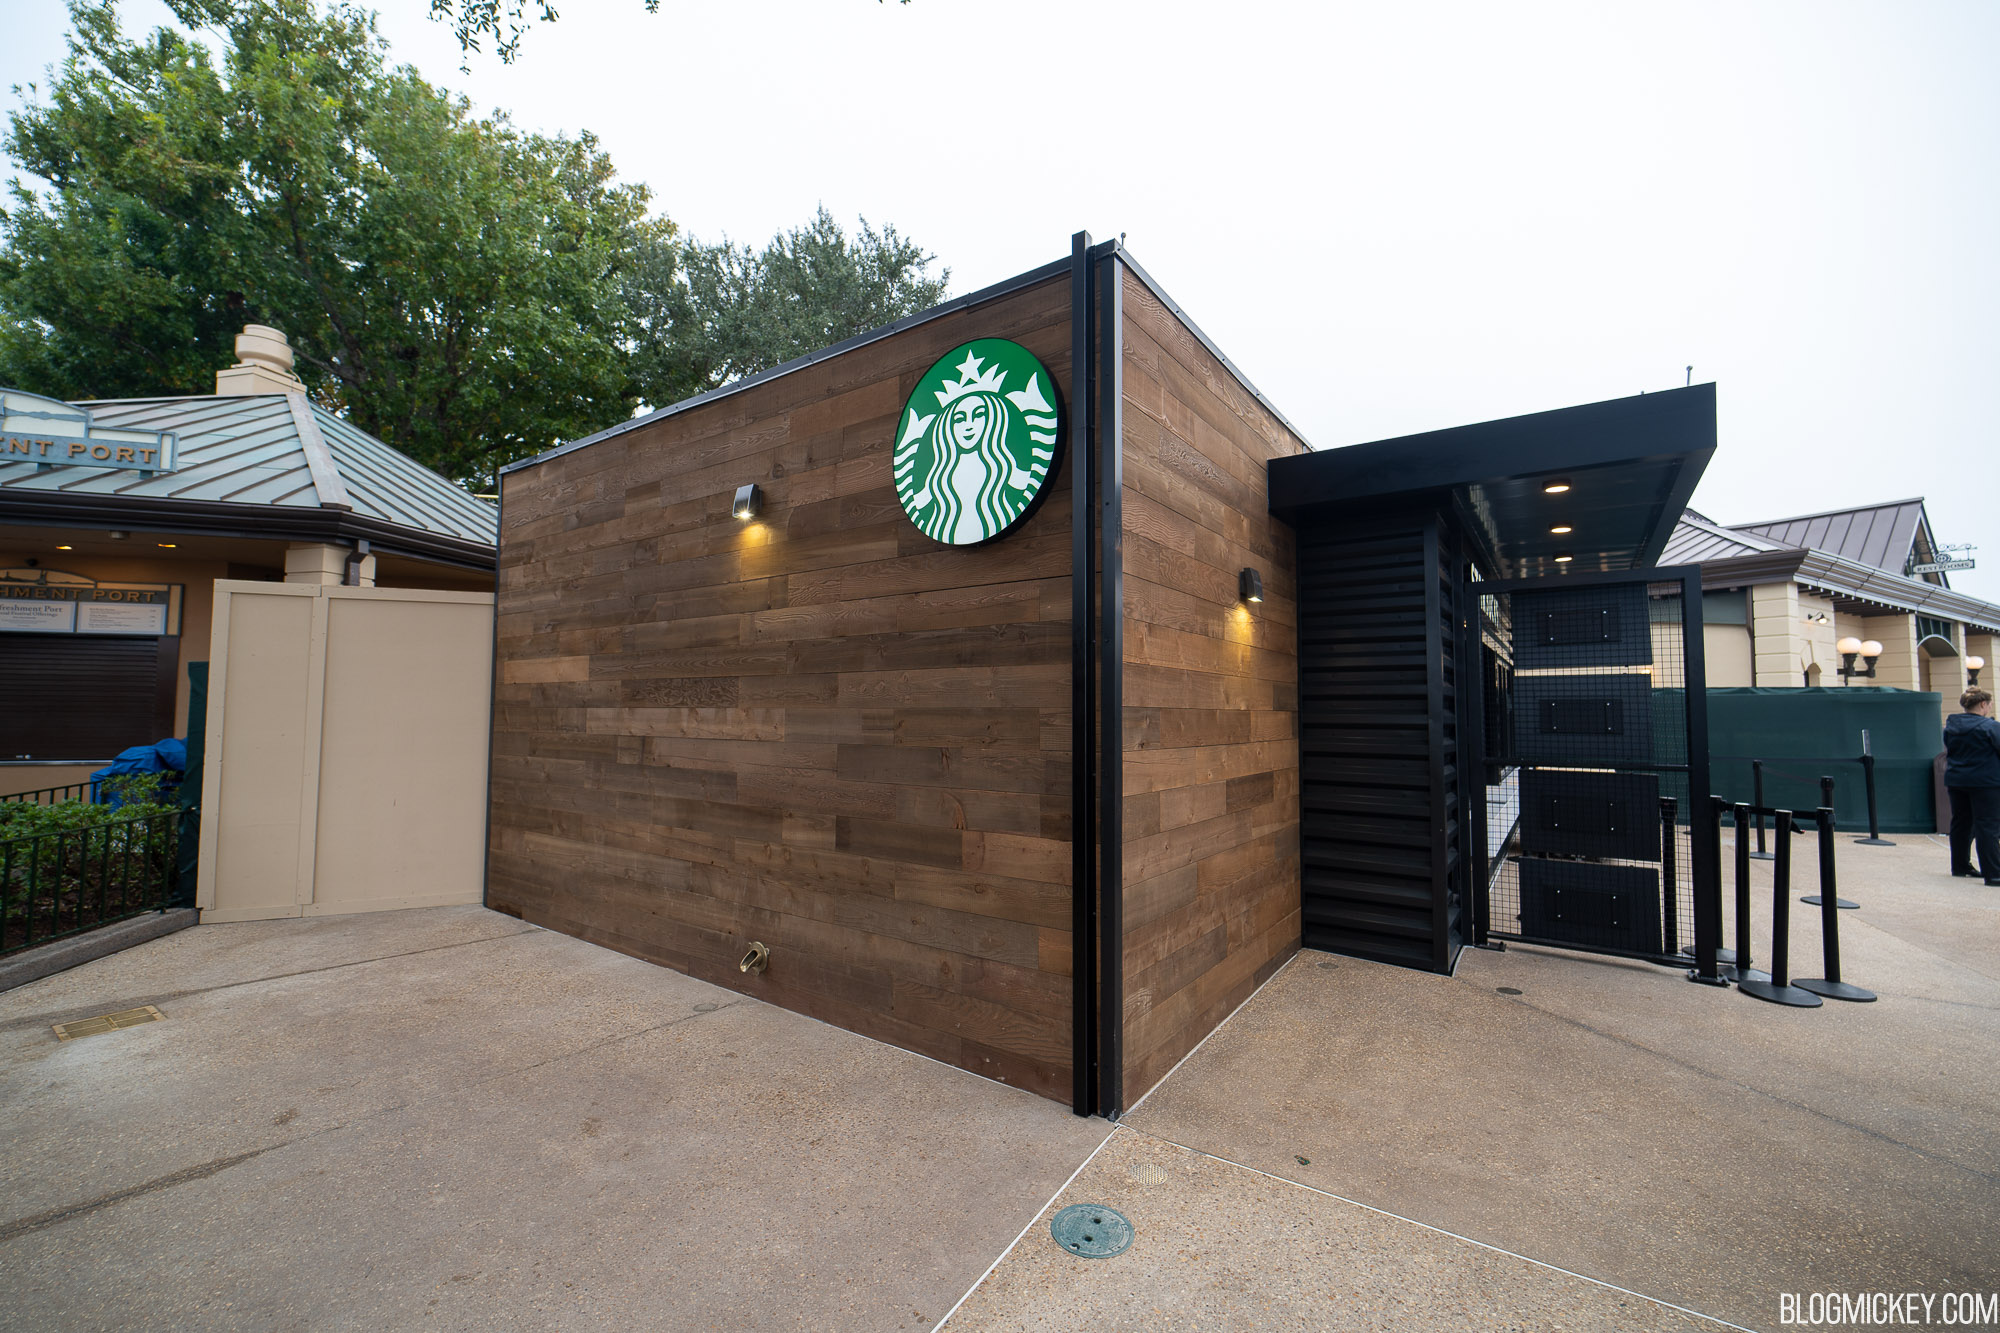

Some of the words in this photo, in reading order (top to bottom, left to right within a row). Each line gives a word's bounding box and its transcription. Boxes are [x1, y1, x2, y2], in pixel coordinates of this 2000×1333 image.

[0, 437, 53, 457] NT
[68, 443, 157, 463] PORT
[1917, 562, 1970, 572] RESTROOMS
[92, 590, 156, 602] PORT
[44, 605, 64, 613] Port
